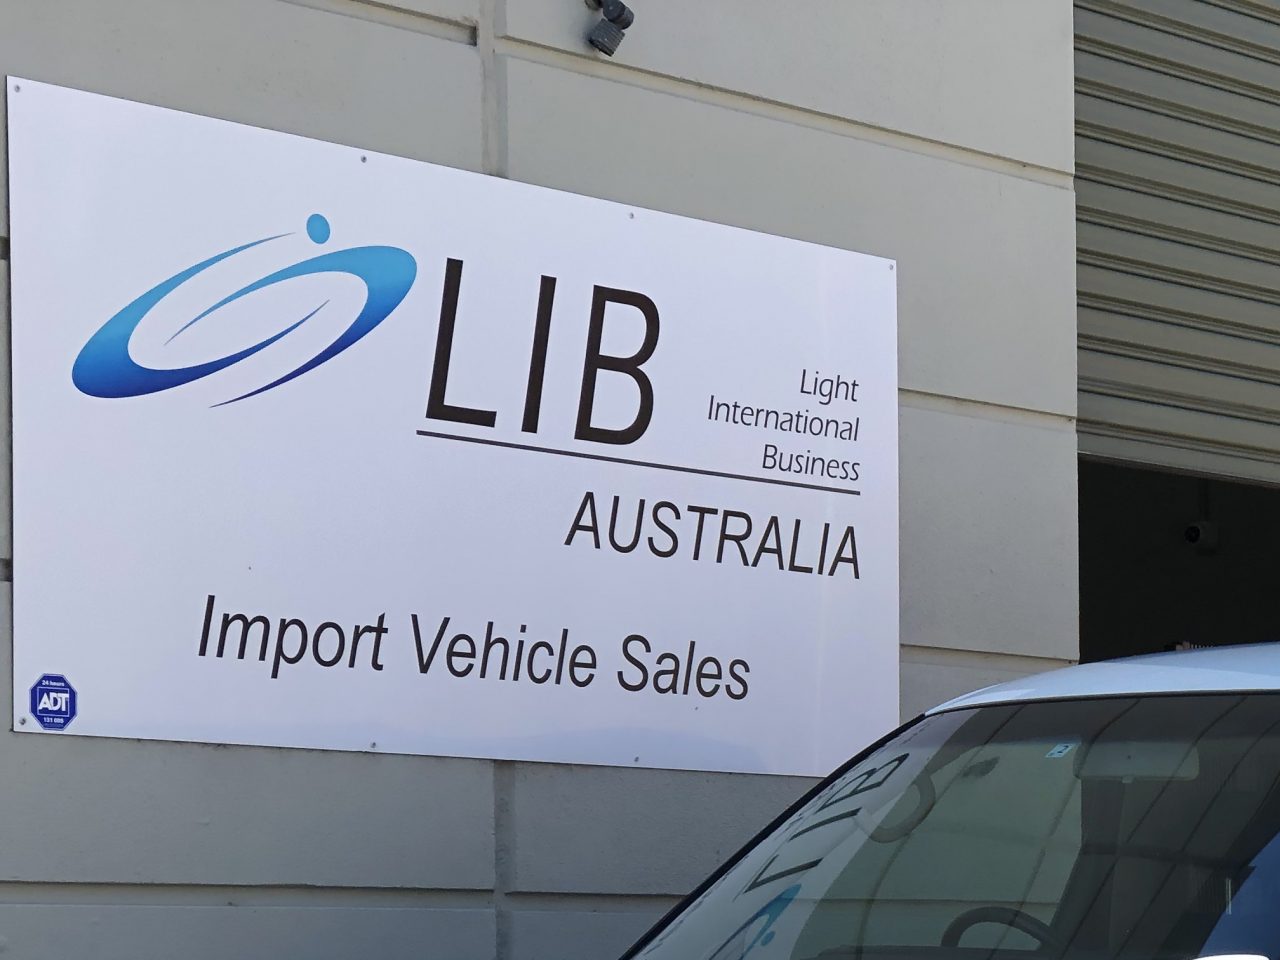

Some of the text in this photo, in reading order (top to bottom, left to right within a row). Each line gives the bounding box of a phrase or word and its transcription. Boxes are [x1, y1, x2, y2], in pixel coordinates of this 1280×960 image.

[425, 257, 660, 446] LIB
[800, 369, 860, 407] Light
[707, 394, 861, 442] International
[762, 444, 861, 481] Business
[564, 491, 861, 580] AUSTRALIA
[198, 594, 752, 702] Import Vehicle Sales
[38, 691, 70, 712] ADT
